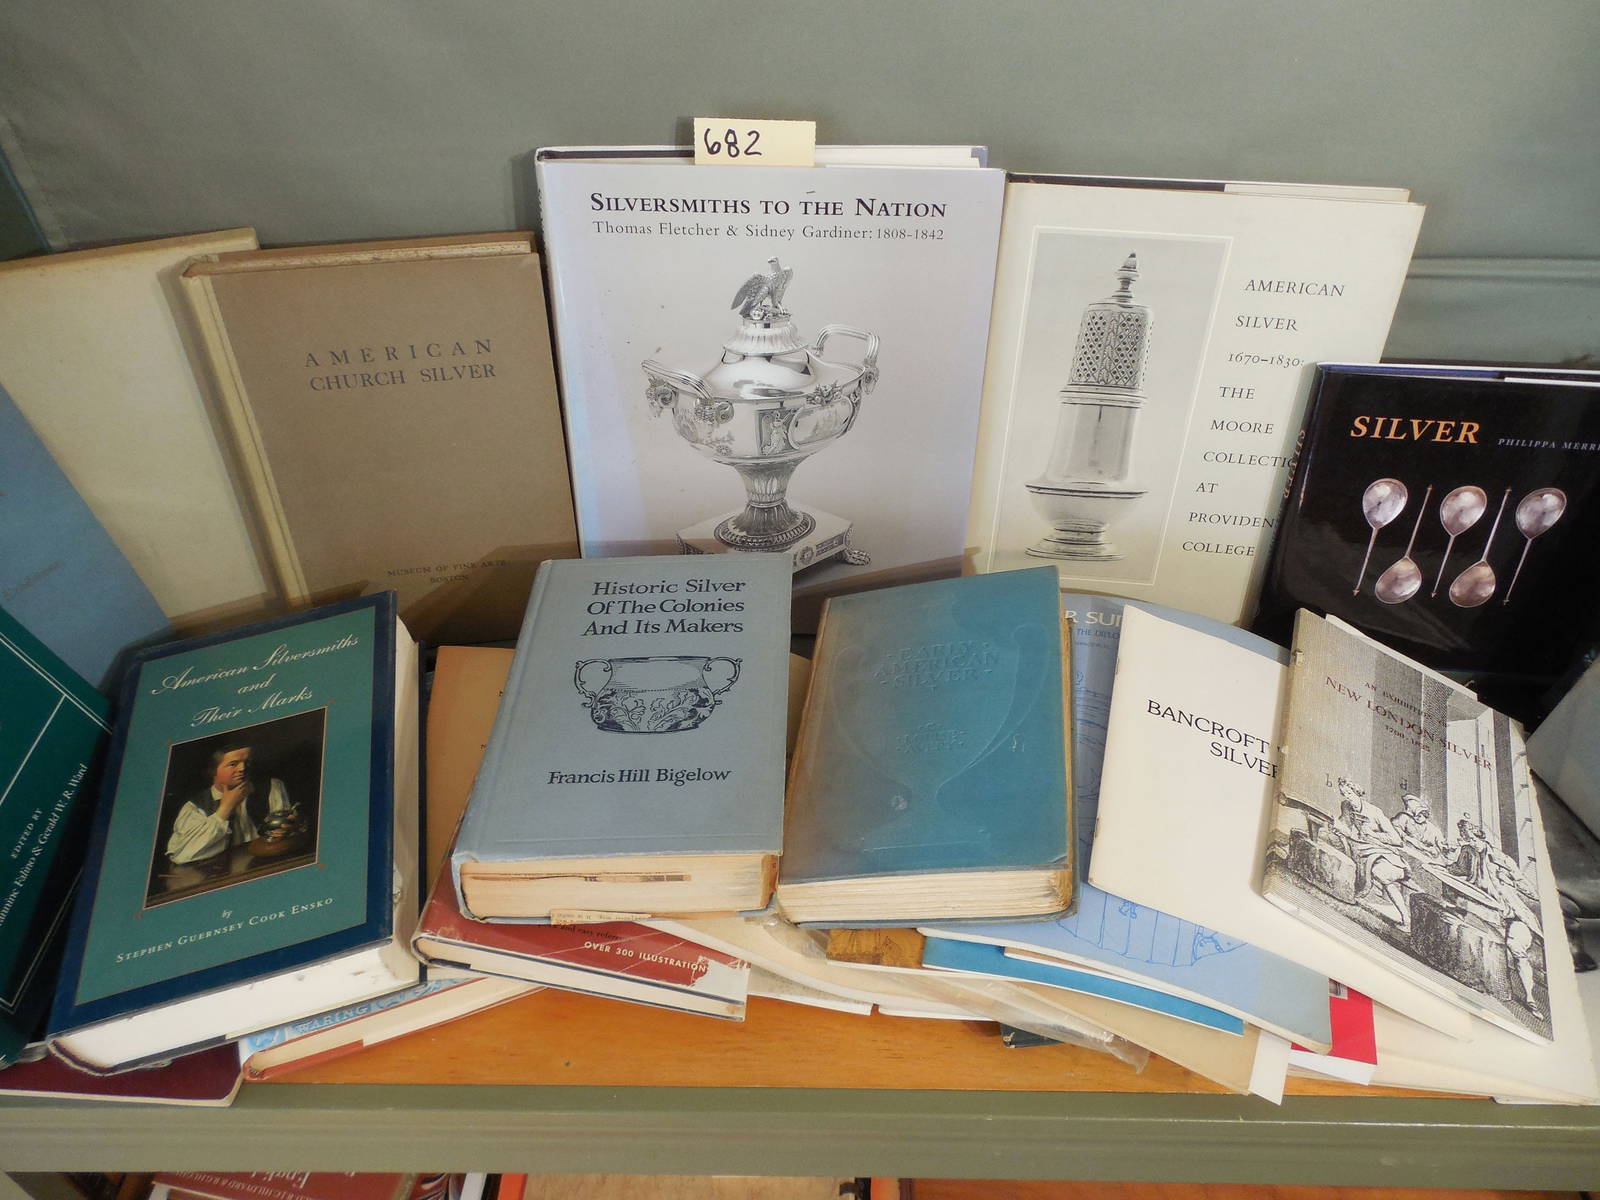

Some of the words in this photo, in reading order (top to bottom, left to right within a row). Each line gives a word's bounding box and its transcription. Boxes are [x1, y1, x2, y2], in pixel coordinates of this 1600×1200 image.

[703, 128, 762, 158] 682
[590, 192, 751, 215] SILVERSMITHS
[759, 200, 790, 215] TO
[799, 199, 844, 217] THE
[855, 198, 948, 218] NATION
[593, 221, 652, 235] Thomas
[659, 222, 720, 237] Fletcher
[726, 225, 739, 237] &
[745, 224, 795, 241] Sidney
[802, 225, 873, 240] Gardiner:
[877, 228, 944, 240] 1808-1842
[1245, 279, 1345, 297] AMERICAN
[1235, 315, 1298, 331] SILVER
[304, 339, 492, 367] AMERICAN
[309, 369, 406, 392] CHURCH
[420, 363, 496, 383] SILVER
[1219, 386, 1256, 400] THE
[1210, 419, 1274, 434] MOORE
[1350, 416, 1481, 444] SILVER
[1498, 438, 1556, 449] PHILIPPA
[1196, 482, 1219, 494] AT
[1188, 512, 1276, 529] PROVIDEN
[1182, 541, 1256, 556] COLLEGE
[592, 580, 679, 596] Historic
[685, 578, 746, 593] Silver
[586, 601, 615, 615] Of
[617, 600, 657, 614] The
[659, 598, 745, 613] Colonies
[582, 620, 629, 636] And
[633, 619, 661, 634] Its
[664, 618, 744, 634] Makers
[151, 666, 249, 695] American
[252, 634, 359, 671] Silversmiths
[874, 651, 1000, 678] AMERICAN
[237, 672, 276, 695] and
[191, 705, 243, 728] Their
[247, 686, 313, 714] Marks
[1147, 699, 1270, 754] BANCROFT
[1326, 676, 1362, 702] NEW
[1367, 700, 1436, 742] LONDON
[1440, 737, 1493, 771] SILVER
[547, 769, 615, 785] Francis
[617, 768, 650, 783] Hill
[656, 767, 732, 787] Bigelow
[31, 846, 43, 856] &
[38, 812, 61, 845] Gerald
[68, 763, 89, 787] Ward
[10, 822, 35, 859] EDITED
[32, 807, 43, 821] BY
[221, 908, 233, 919] by
[115, 941, 174, 963] STEPHEN
[177, 922, 245, 945] GUERNSEY
[248, 910, 286, 926] COOK
[290, 897, 334, 915] ENSKO
[584, 941, 611, 954] OVER
[615, 947, 634, 958] 300
